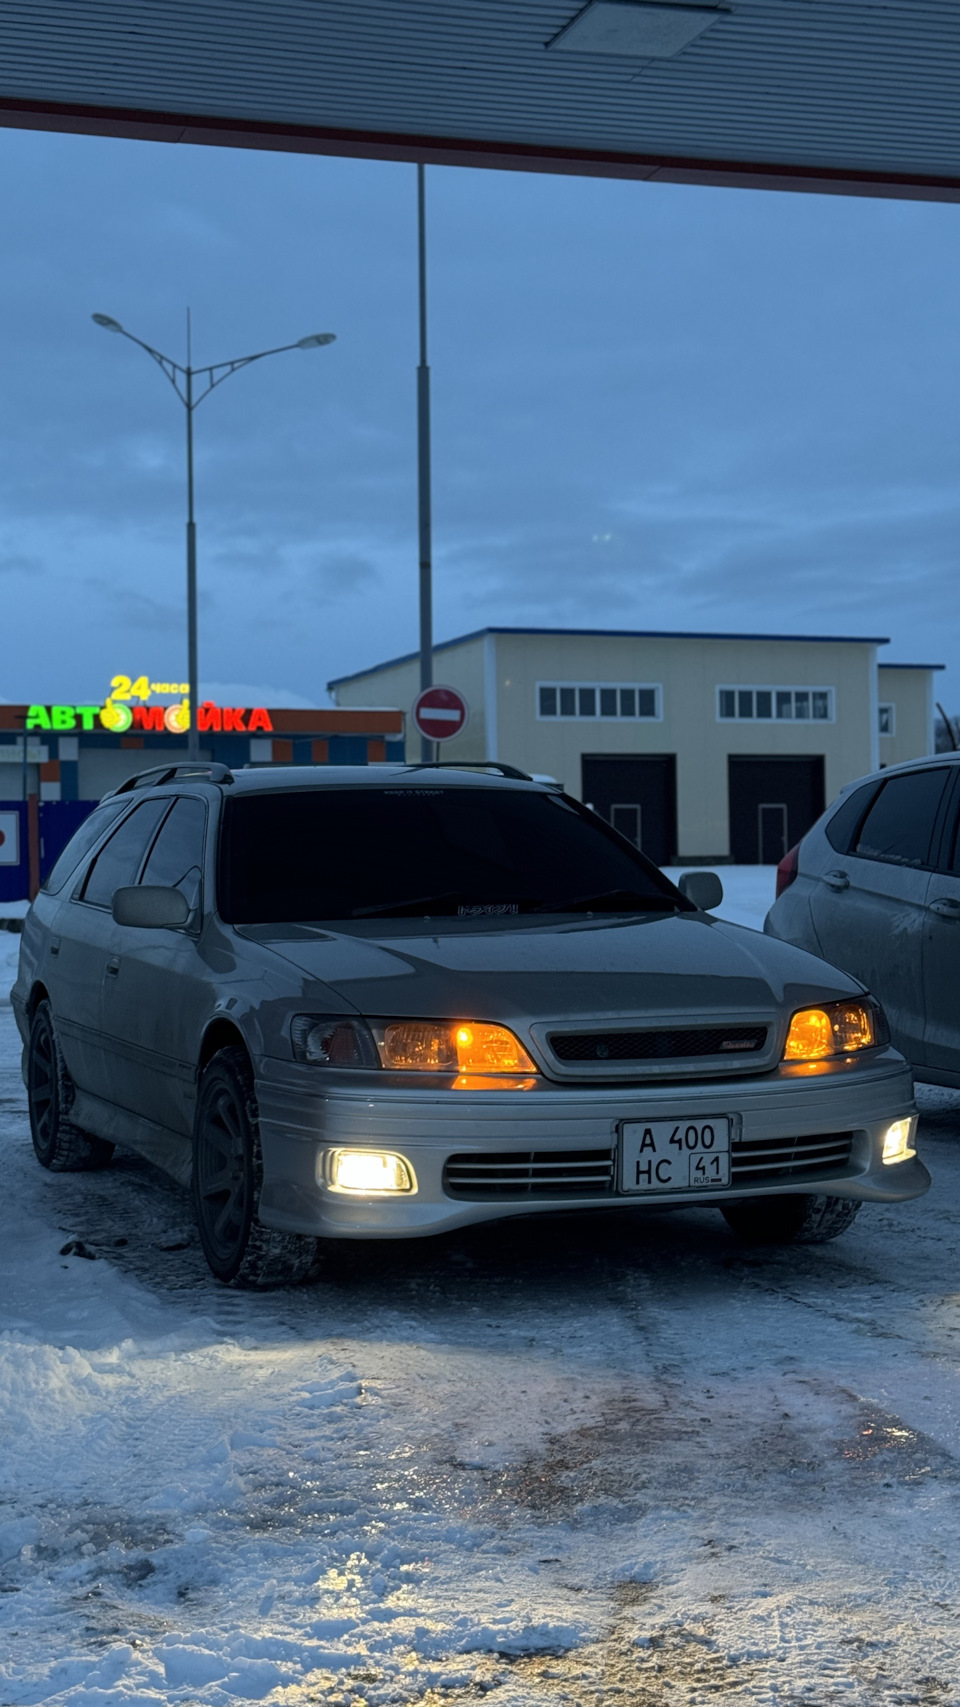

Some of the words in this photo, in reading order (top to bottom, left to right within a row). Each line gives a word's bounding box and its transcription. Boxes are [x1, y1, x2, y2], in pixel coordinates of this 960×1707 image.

[110, 675, 151, 701] 24
[151, 682, 190, 694] часа
[26, 699, 273, 733] АВТОМОЙКА
[639, 1128, 656, 1153] А
[669, 1124, 715, 1151] 400
[636, 1159, 672, 1185] НС
[695, 1156, 720, 1175] 41
